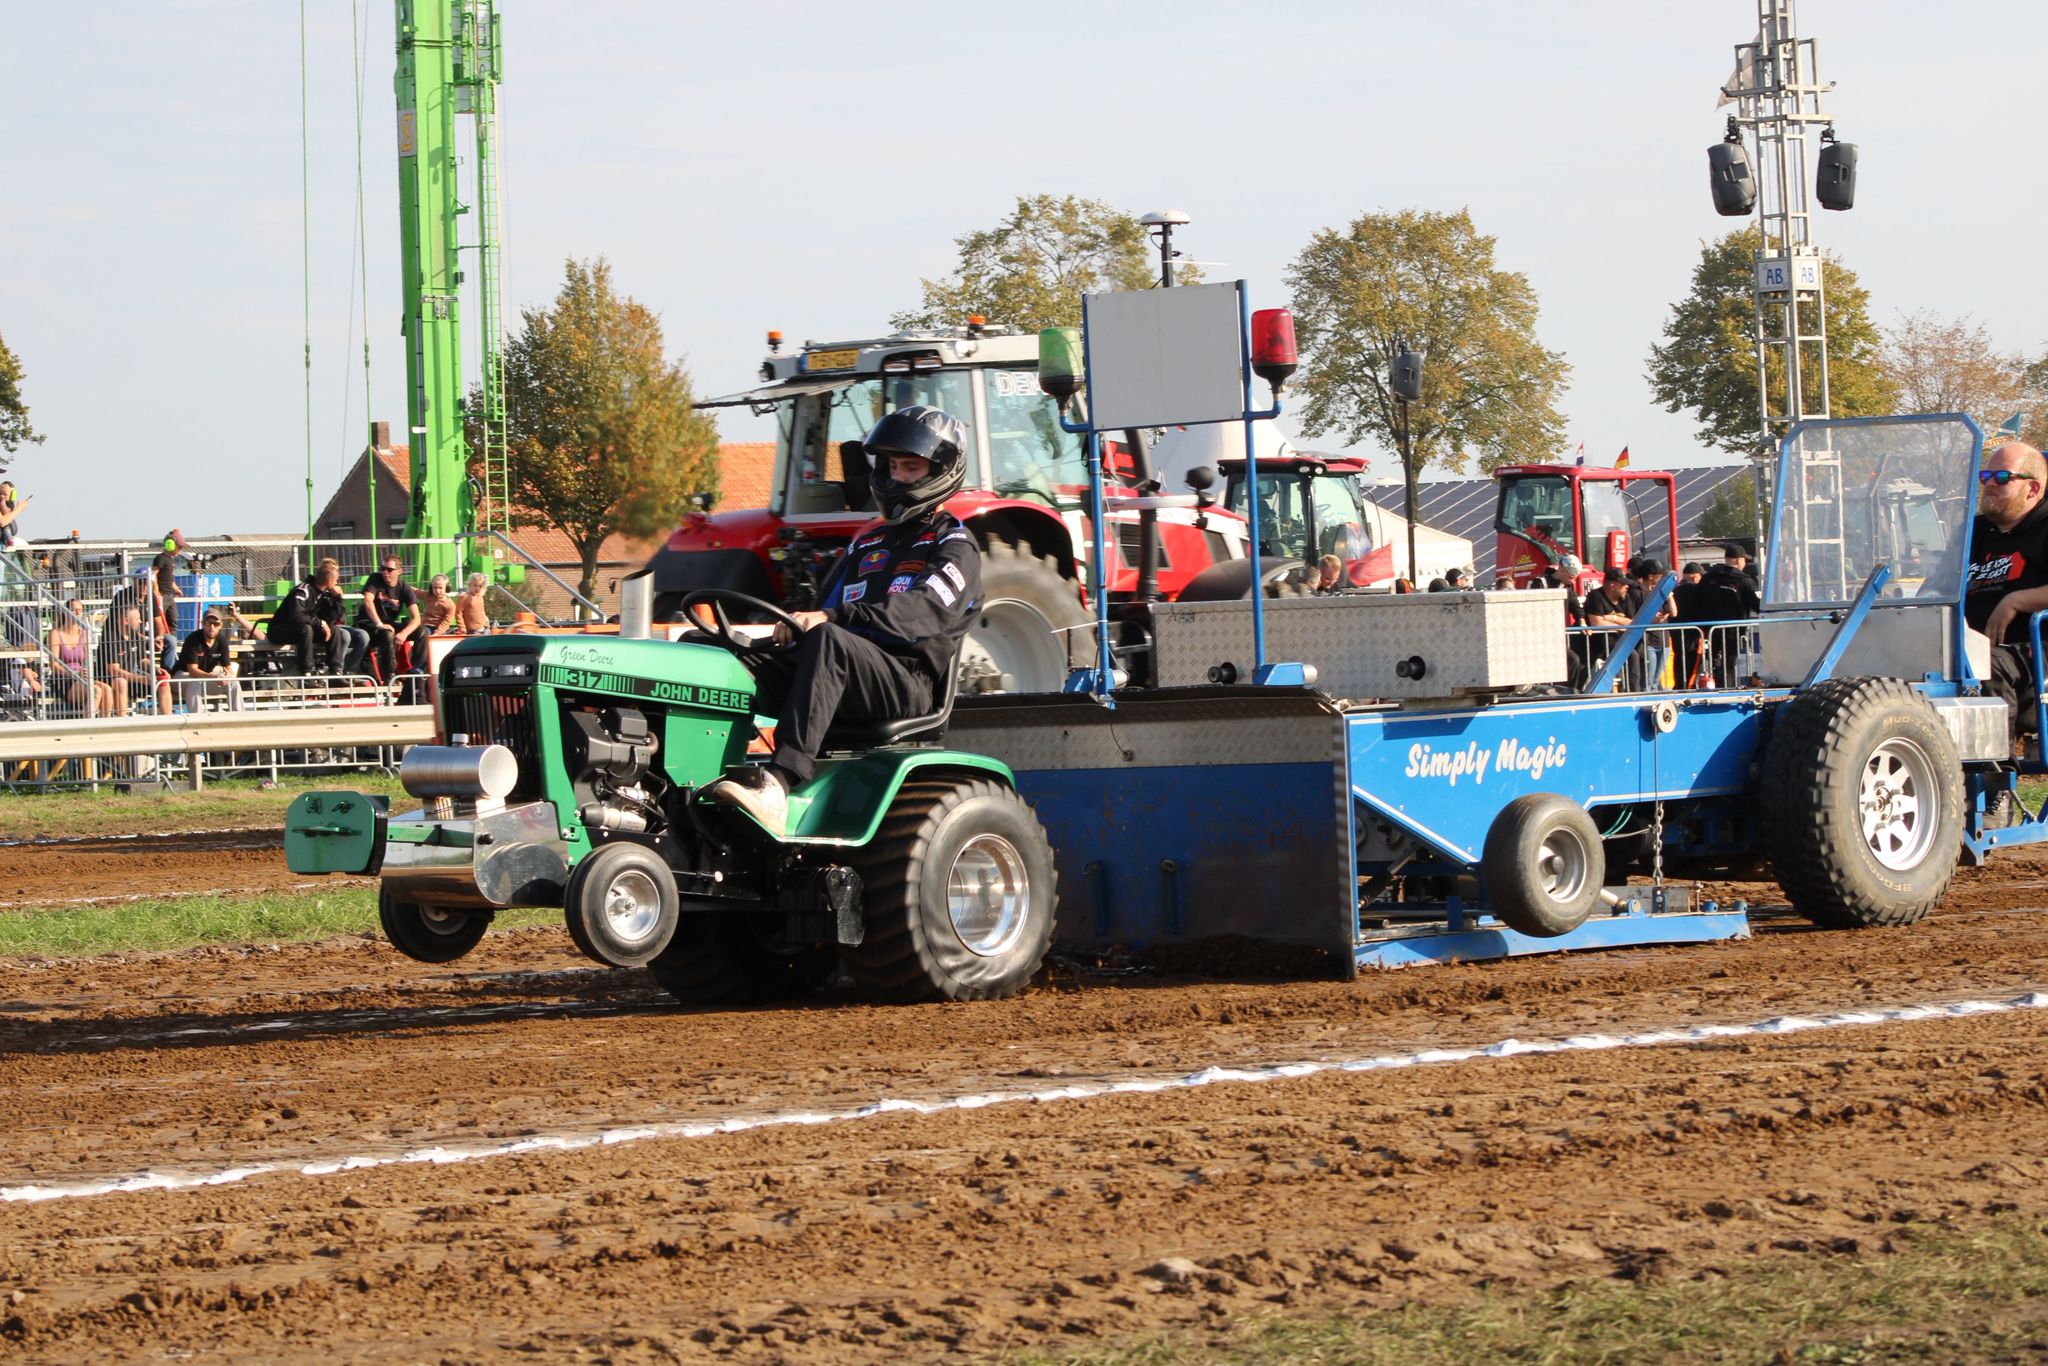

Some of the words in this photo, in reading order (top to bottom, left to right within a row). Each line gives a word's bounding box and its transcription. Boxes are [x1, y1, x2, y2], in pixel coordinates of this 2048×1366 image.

[1766, 268, 1783, 285] AB
[1801, 267, 1815, 283] AB
[560, 646, 586, 664] Green
[589, 649, 615, 665] Deere
[567, 669, 603, 689] 317
[650, 682, 692, 702] JOHN
[699, 688, 750, 709] DEERE
[1405, 741, 1491, 787] Simply
[1495, 735, 1568, 780] Magic
